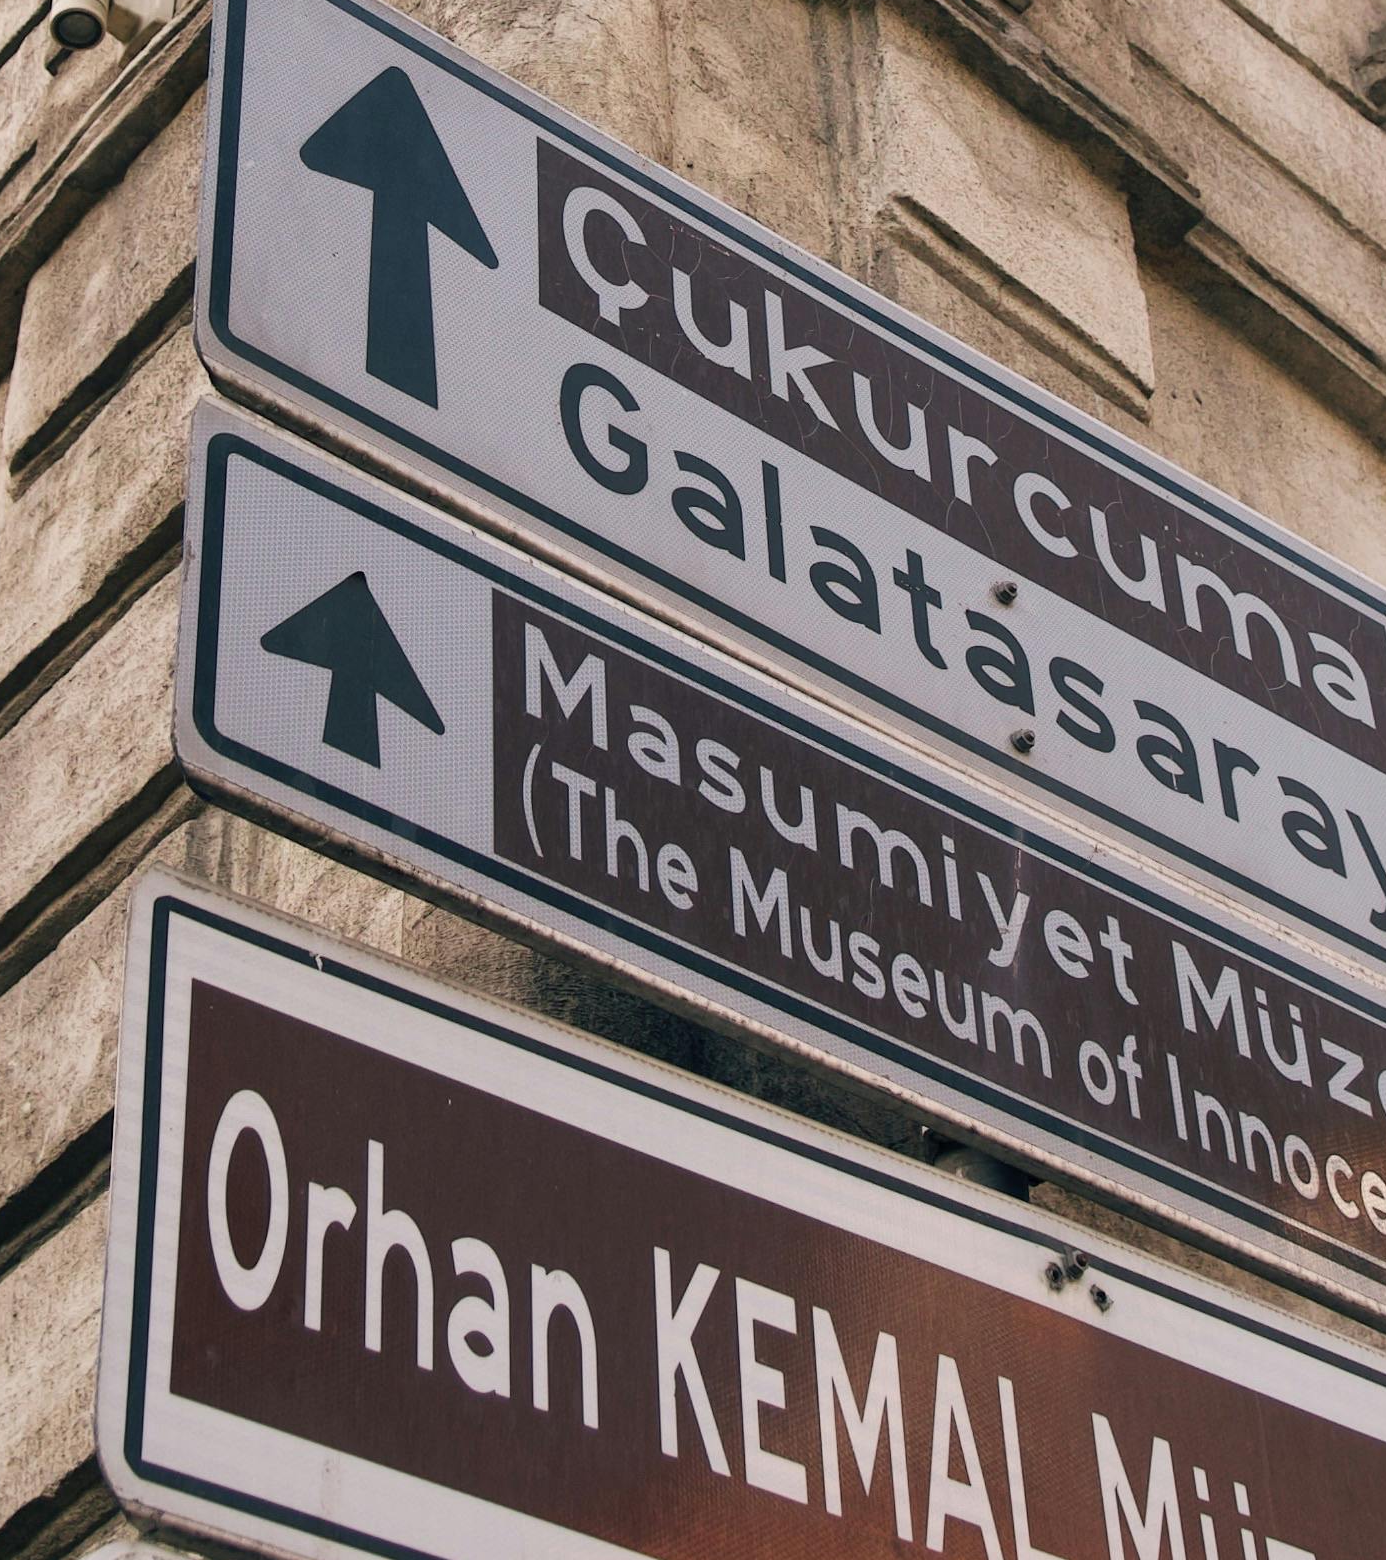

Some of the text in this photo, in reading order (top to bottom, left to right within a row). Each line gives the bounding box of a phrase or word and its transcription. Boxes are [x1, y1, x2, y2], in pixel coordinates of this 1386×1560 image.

[560, 185, 1373, 724] Çukurcuma
[521, 625, 1139, 1005] Masumiyet
[521, 743, 699, 911] (The
[733, 847, 1054, 1081] Museum
[1078, 1030, 1147, 1118] of
[208, 1089, 600, 1432] Orhan
